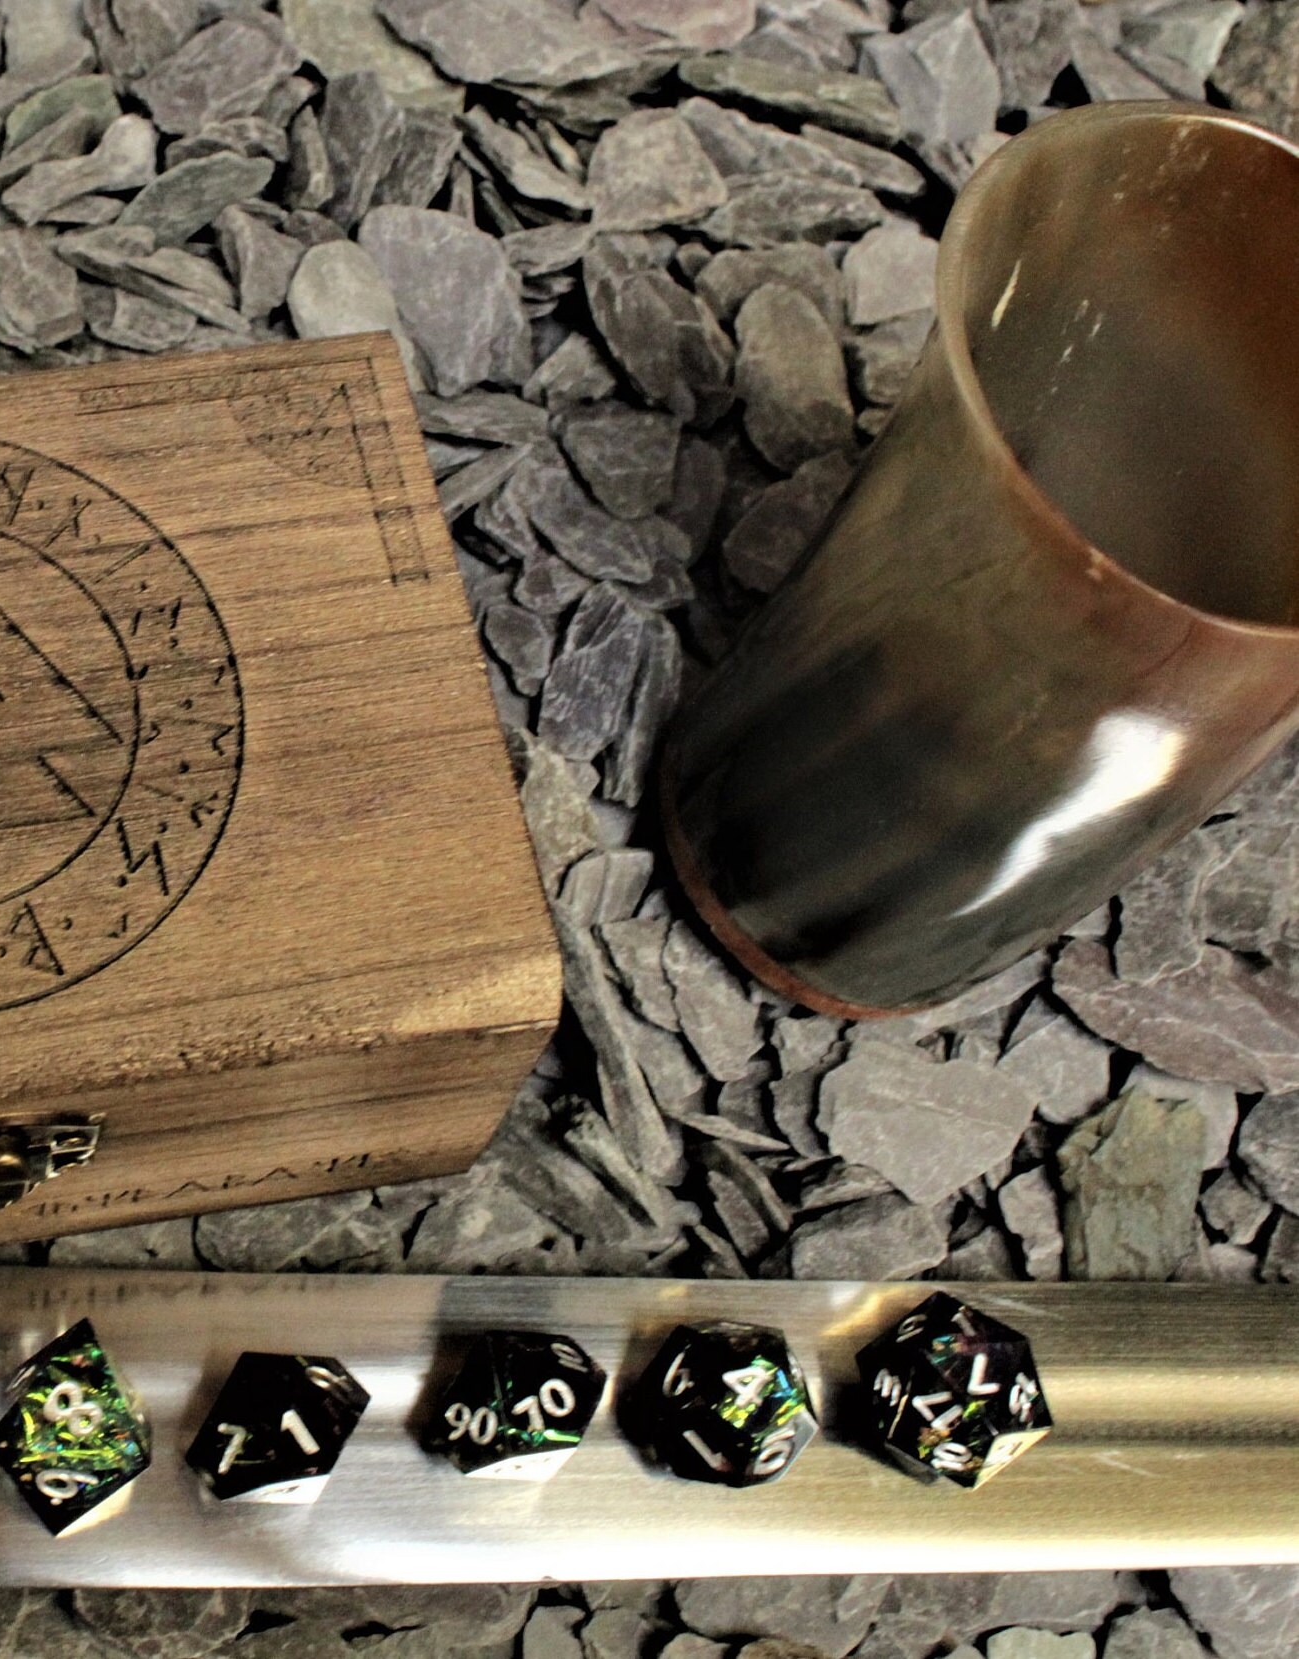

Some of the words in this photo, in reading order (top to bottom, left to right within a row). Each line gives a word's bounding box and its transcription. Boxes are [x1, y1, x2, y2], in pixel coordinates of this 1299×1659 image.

[43, 1381, 101, 1436] 8
[511, 1378, 576, 1433] 70
[721, 1365, 768, 1408] 4
[281, 1409, 321, 1455] 1
[444, 1402, 498, 1446] 90
[217, 1423, 247, 1475] 7
